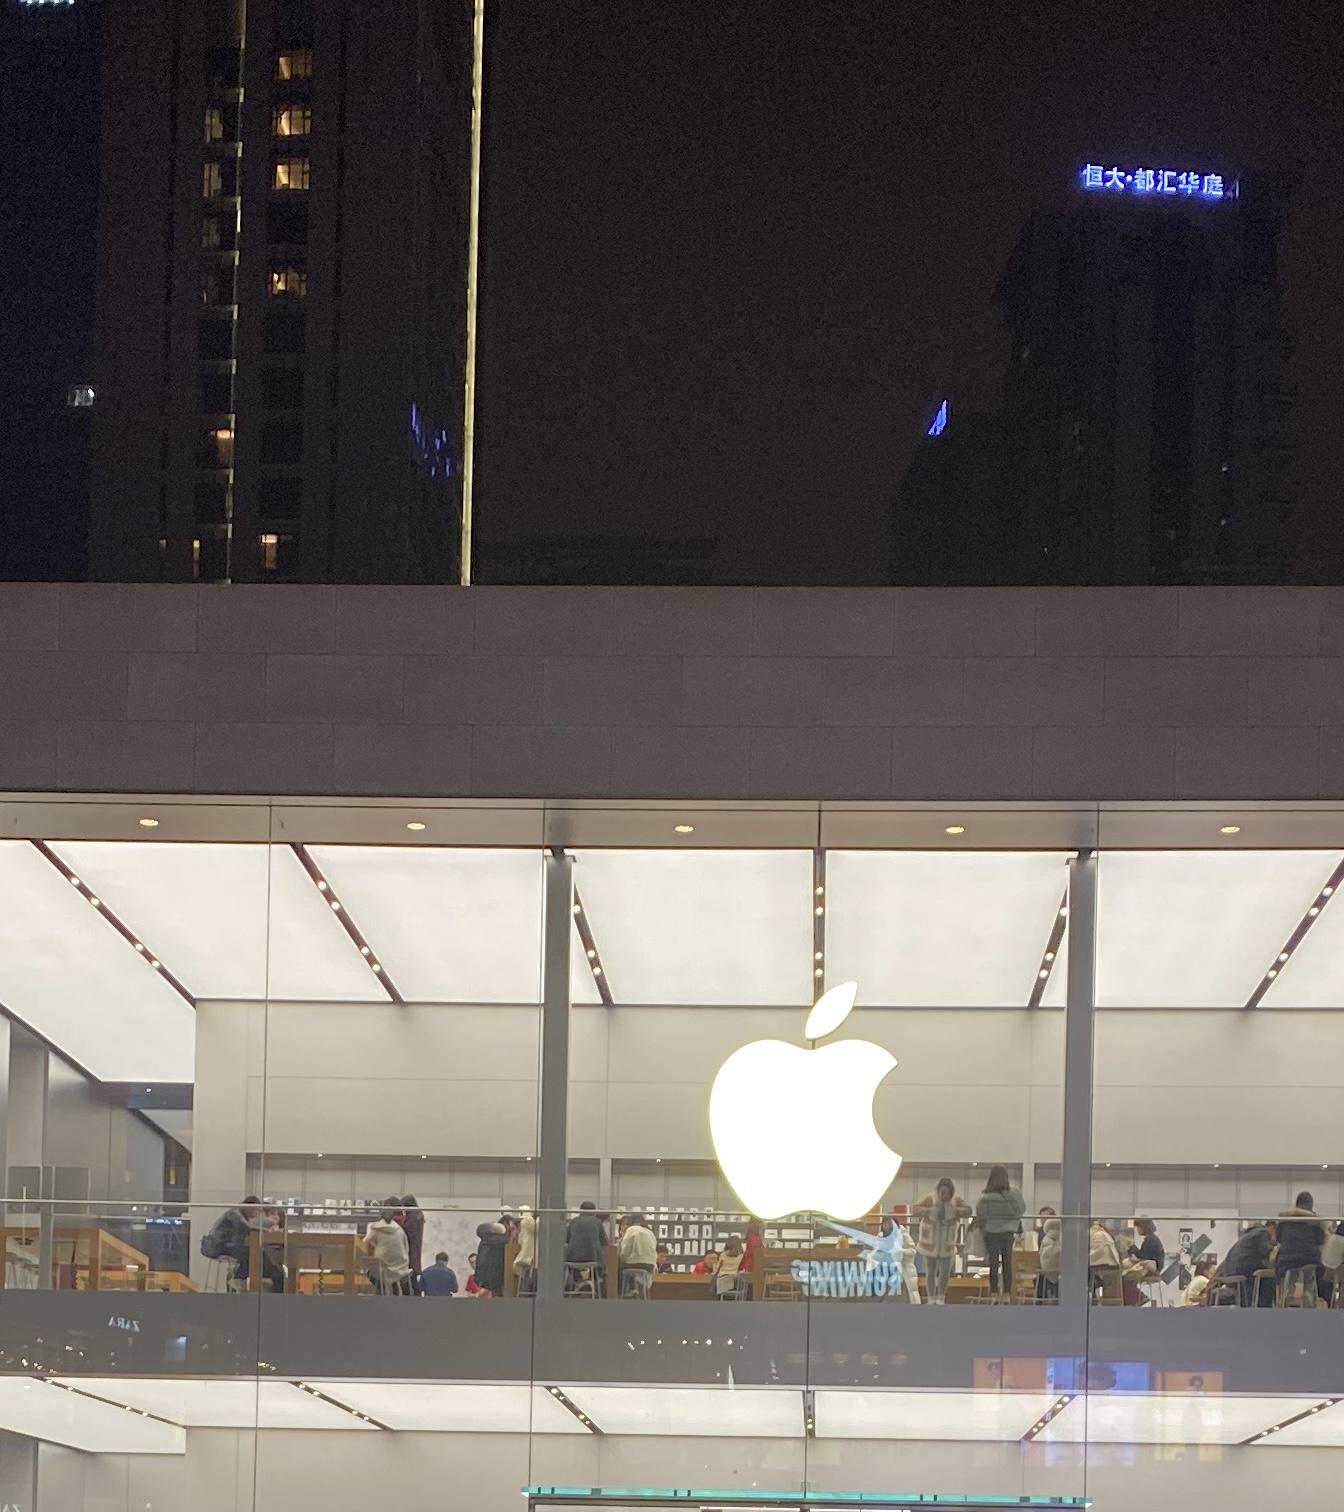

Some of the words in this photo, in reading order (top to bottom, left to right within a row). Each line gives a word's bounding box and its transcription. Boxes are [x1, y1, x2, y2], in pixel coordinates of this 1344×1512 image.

[1081, 163, 1224, 195] 恒大·都汇华庭
